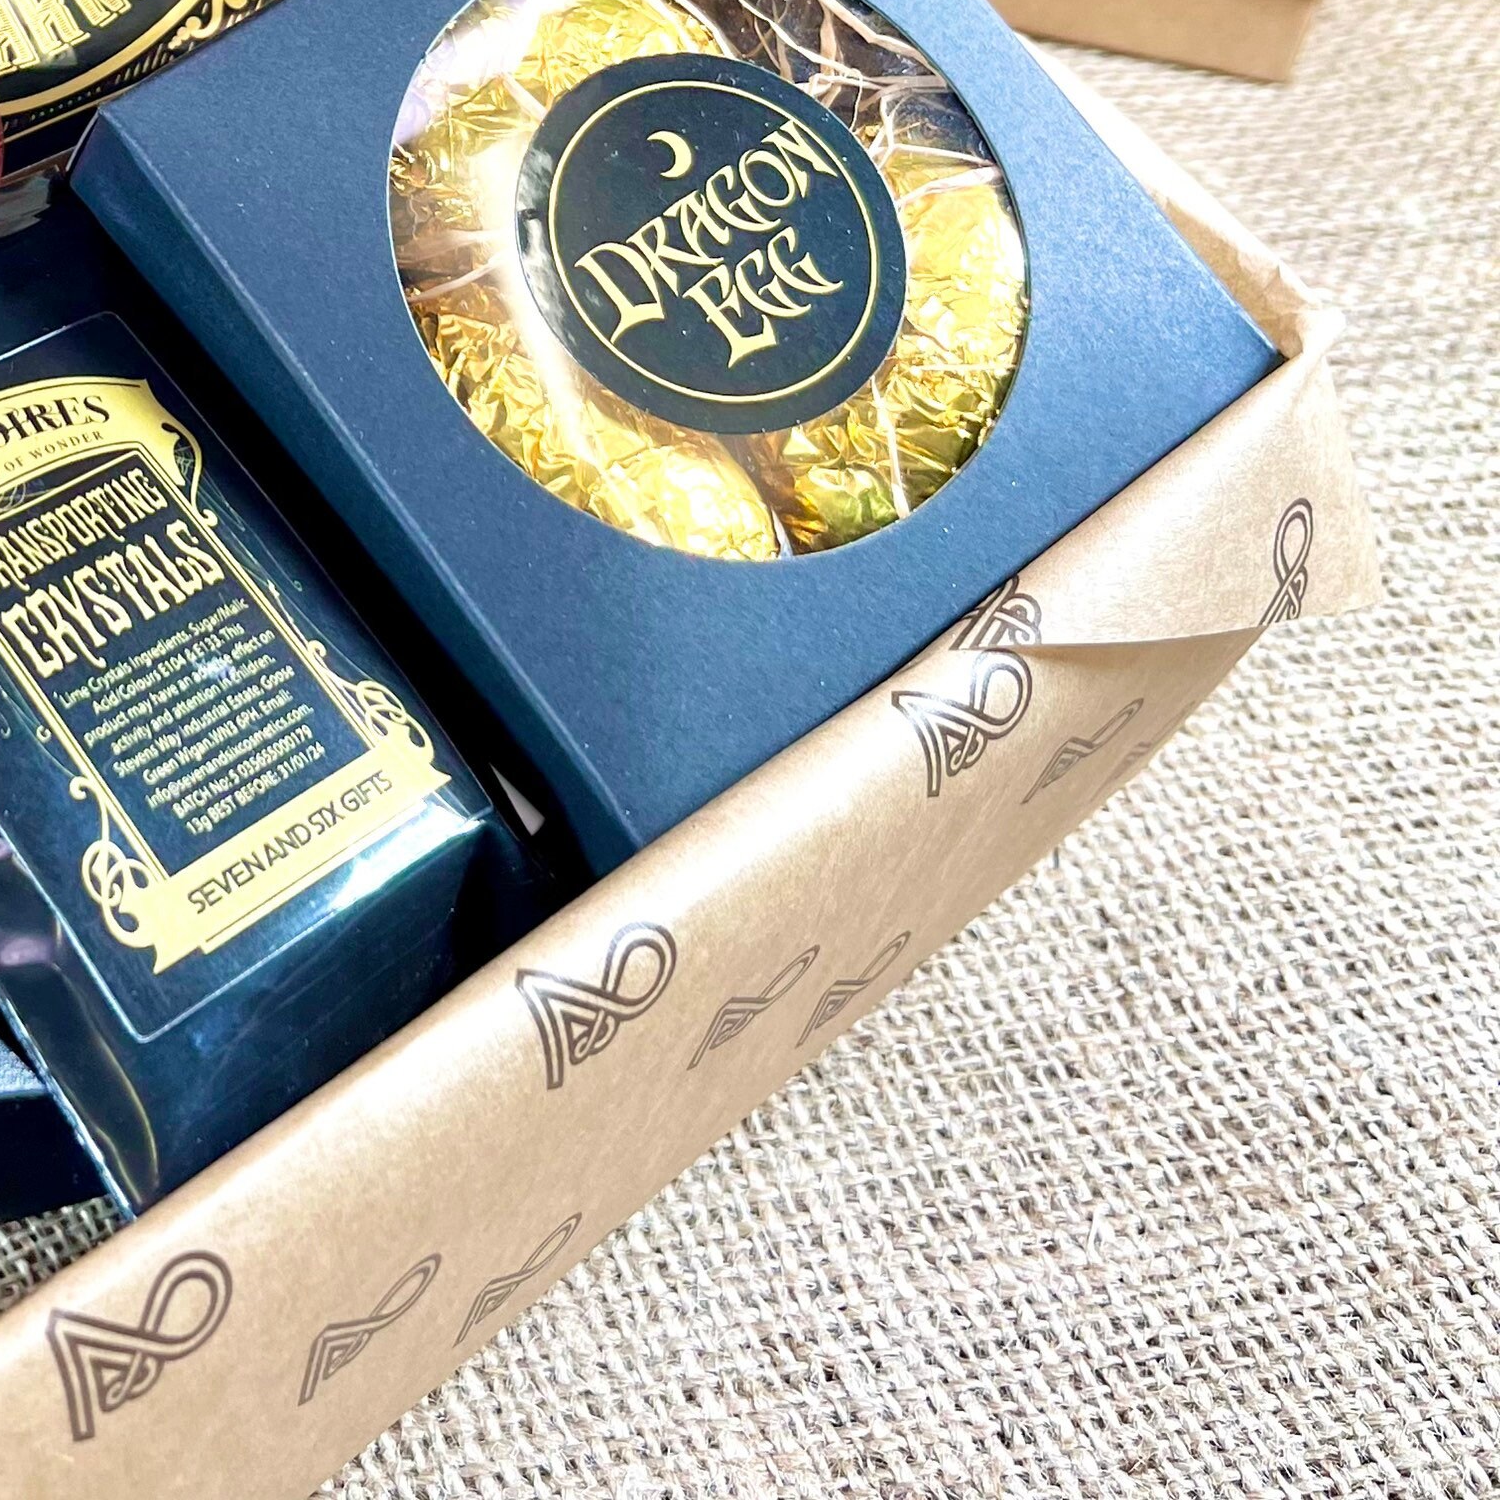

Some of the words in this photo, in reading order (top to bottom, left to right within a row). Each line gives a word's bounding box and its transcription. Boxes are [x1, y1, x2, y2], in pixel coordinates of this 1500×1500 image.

[574, 119, 839, 345] DRAGON
[683, 228, 844, 369] EGG
[3, 455, 25, 473] OF
[29, 421, 103, 469] WONDER
[1, 519, 226, 680] CRYSTALS
[86, 659, 133, 695] Crystals
[187, 593, 250, 638] Sugar/Malic
[81, 710, 130, 748] product
[126, 698, 154, 723] may
[148, 682, 179, 707] have
[177, 675, 193, 691] an
[229, 633, 262, 660] effect
[258, 627, 275, 644] on
[90, 667, 162, 717] Acid/Colours
[158, 652, 188, 678] E104
[220, 619, 245, 641] This
[108, 720, 154, 758] activity
[148, 708, 174, 730] and
[170, 681, 221, 719] attention
[217, 675, 232, 691] in
[111, 741, 159, 778] Stevens
[154, 727, 184, 756] Way
[177, 699, 231, 739] Industrial
[259, 662, 295, 691] Goose
[140, 754, 179, 785] Green
[258, 687, 294, 716] Email:
[171, 785, 214, 819] BATCH
[185, 811, 212, 836] 13g
[207, 794, 238, 821] BEST
[233, 769, 281, 805] BEFORE:
[275, 741, 327, 779] 31/01/24
[183, 850, 268, 914] SEVEN
[258, 819, 315, 866] AND
[305, 798, 346, 836] SIX
[336, 768, 394, 815] GIFTS
